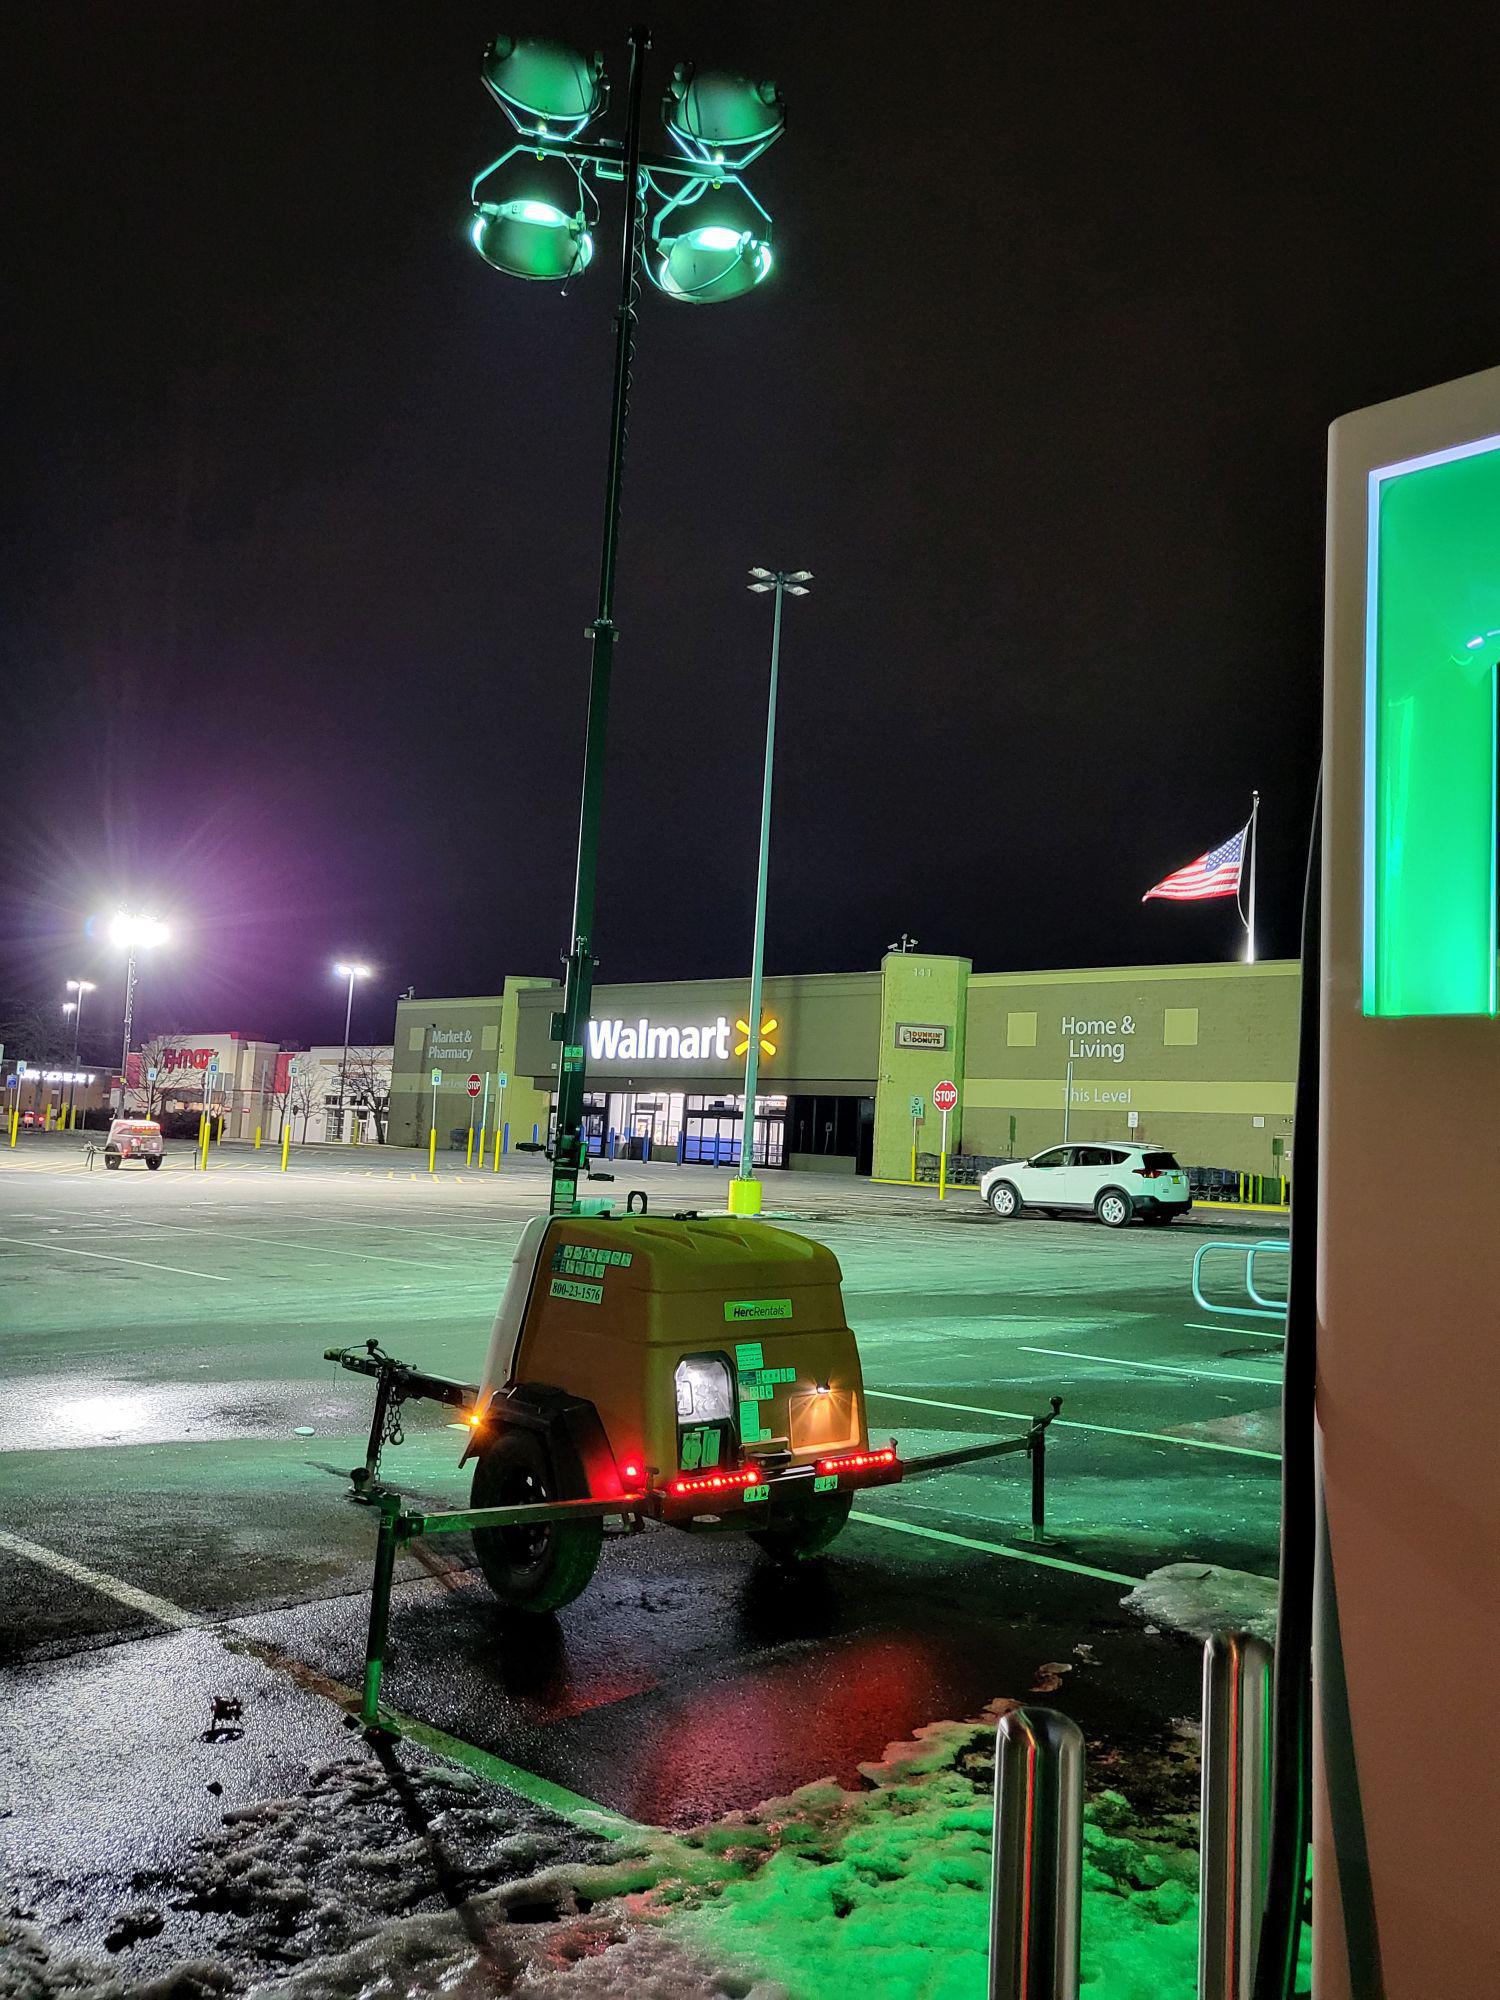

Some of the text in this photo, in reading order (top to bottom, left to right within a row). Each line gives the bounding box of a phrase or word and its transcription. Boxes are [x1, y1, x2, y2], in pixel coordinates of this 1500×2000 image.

[913, 967, 933, 977] 141
[1061, 1015, 1136, 1035] Home &
[432, 1029, 473, 1043] Market &
[588, 1016, 731, 1060] Walmart
[912, 1037, 941, 1045] DONUTS
[428, 1046, 474, 1063] Pharmacy
[1069, 1039, 1125, 1063] Living
[467, 1081, 481, 1090] STOP
[935, 1090, 956, 1102] STOP
[1062, 1087, 1132, 1104] This Level
[552, 1282, 602, 1301] 800-23-1576
[733, 1305, 787, 1317] HercRentals
